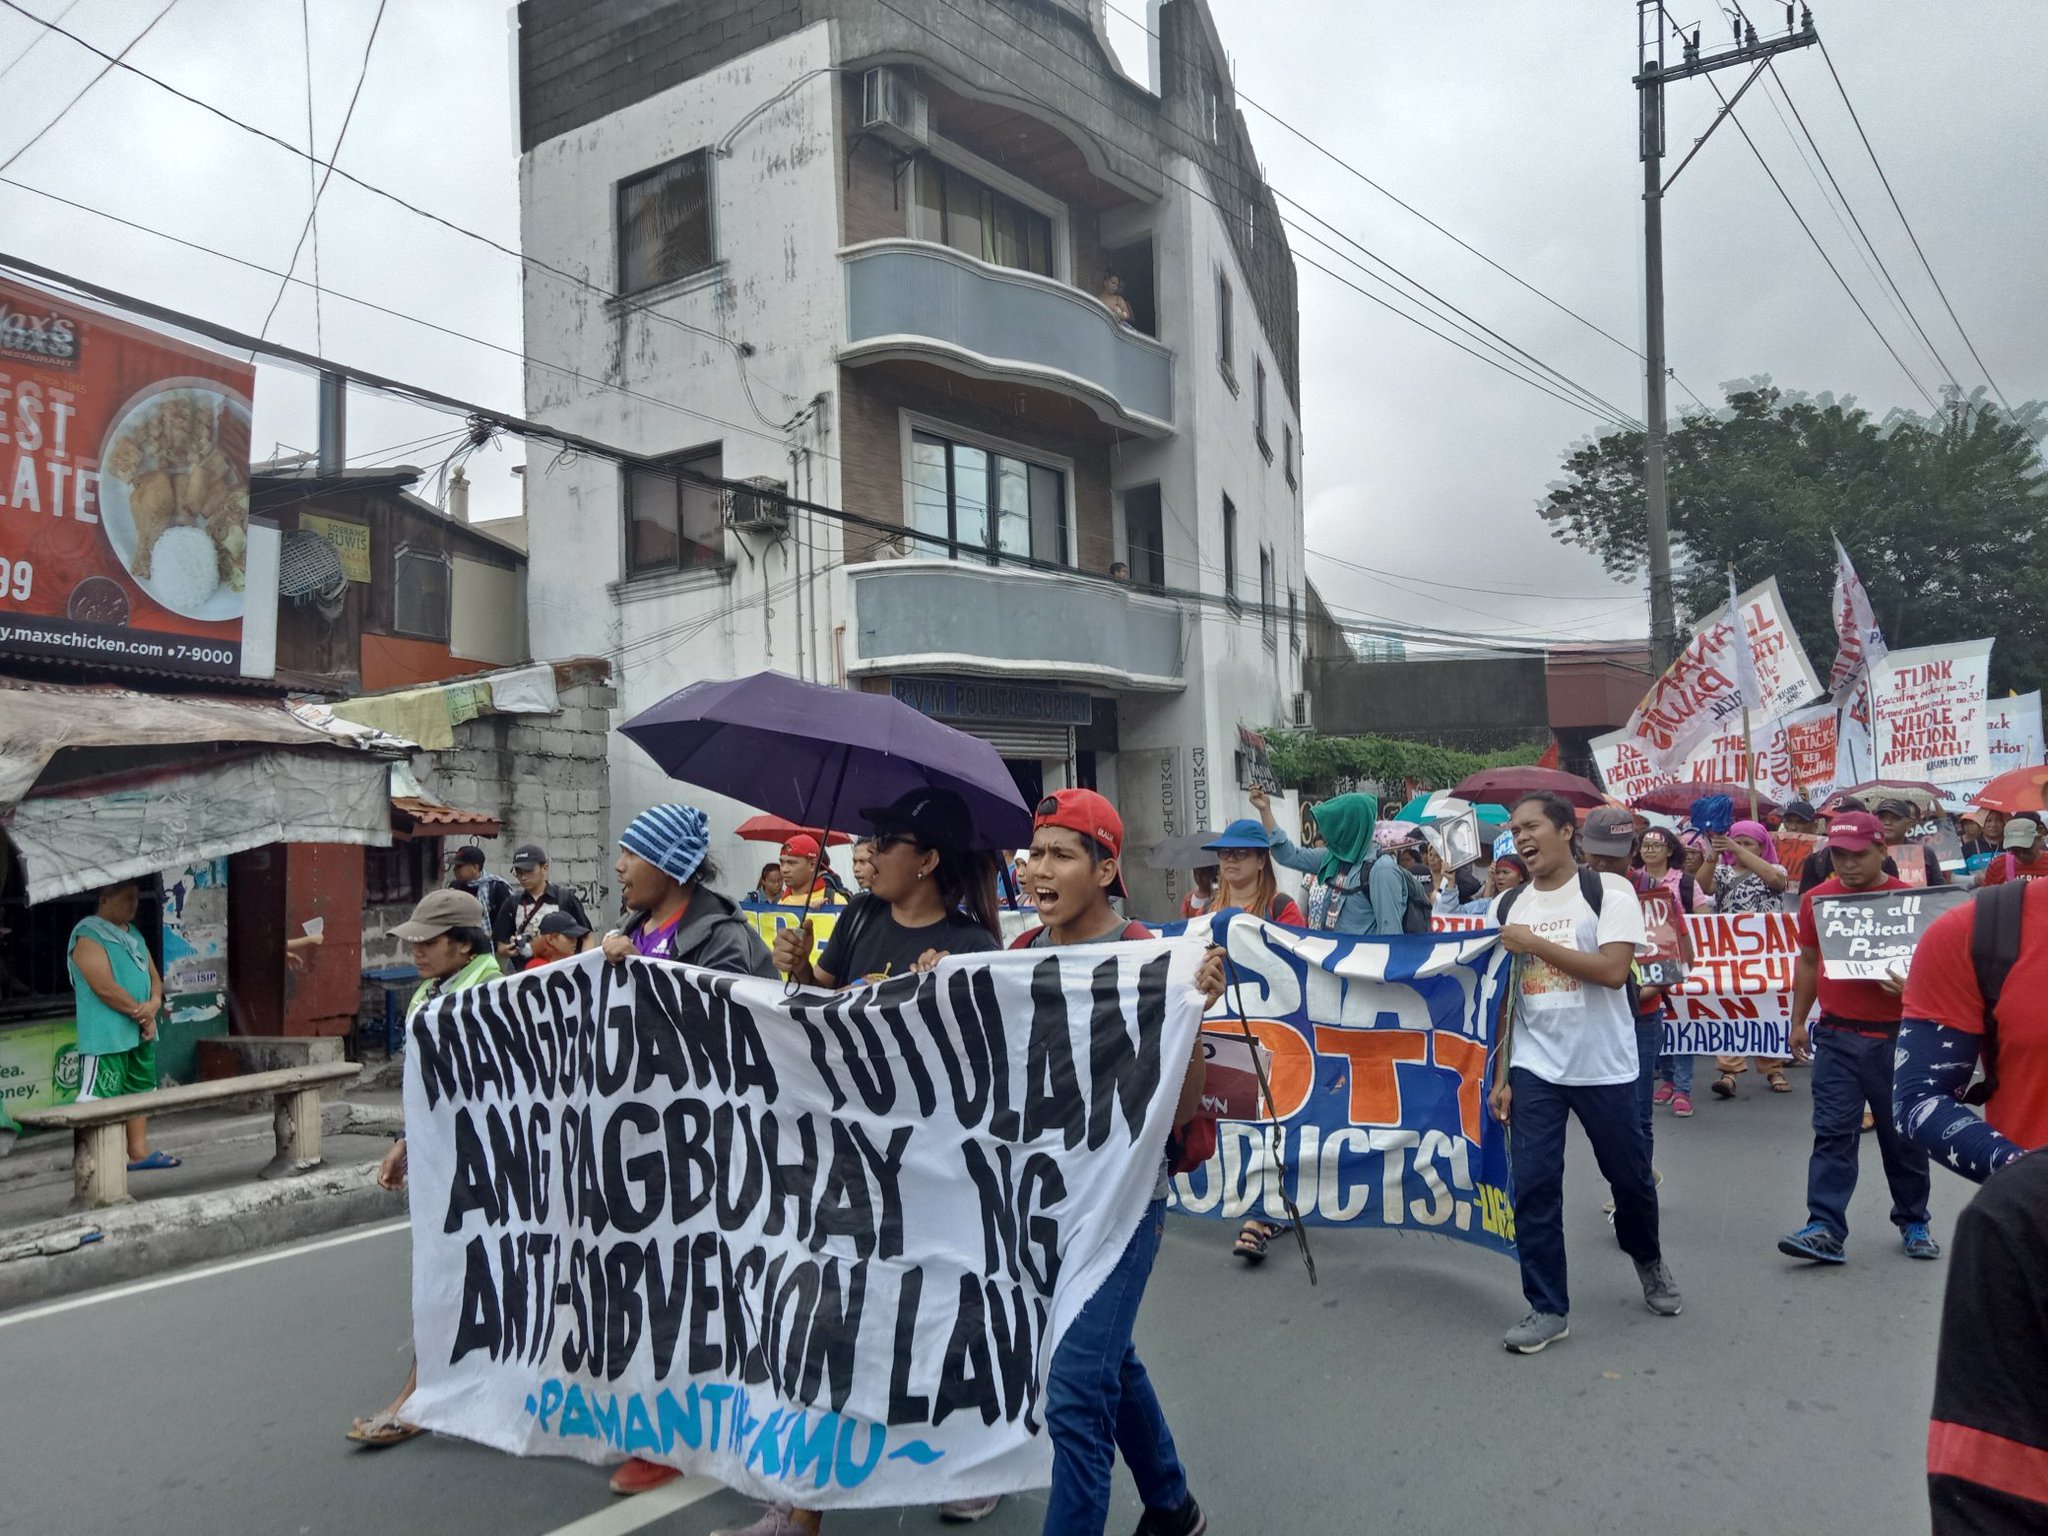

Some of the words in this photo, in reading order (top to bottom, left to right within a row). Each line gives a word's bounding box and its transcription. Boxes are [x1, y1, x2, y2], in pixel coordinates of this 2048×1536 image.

[0, 452, 98, 524] ATE
[1894, 661, 1953, 691] JUNK
[956, 684, 1031, 715] POULTRY
[1034, 691, 1091, 722] SUPPLY
[1890, 707, 1953, 733] WHOLE
[1960, 708, 1975, 722] of
[1712, 735, 1746, 755] THE
[1891, 726, 1957, 750] NATION
[1606, 758, 1651, 785] PEACE
[1692, 751, 1768, 784] KILLING
[1162, 783, 1174, 837] POULTRY
[1194, 780, 1207, 833] POULT
[1822, 900, 1875, 919] Free
[1887, 895, 1922, 917] all
[1825, 916, 1914, 937] Political
[412, 959, 779, 1111] MANGGAGAWA
[777, 950, 1172, 1151] TUTULAN
[0, 1064, 25, 1079] ea.
[443, 1101, 551, 1234] ANG
[560, 1097, 914, 1261] PAGBUHAY
[961, 1137, 1067, 1298] NG
[449, 1231, 867, 1414] ANTI-SUBVERSION
[887, 1265, 1048, 1437] LAW
